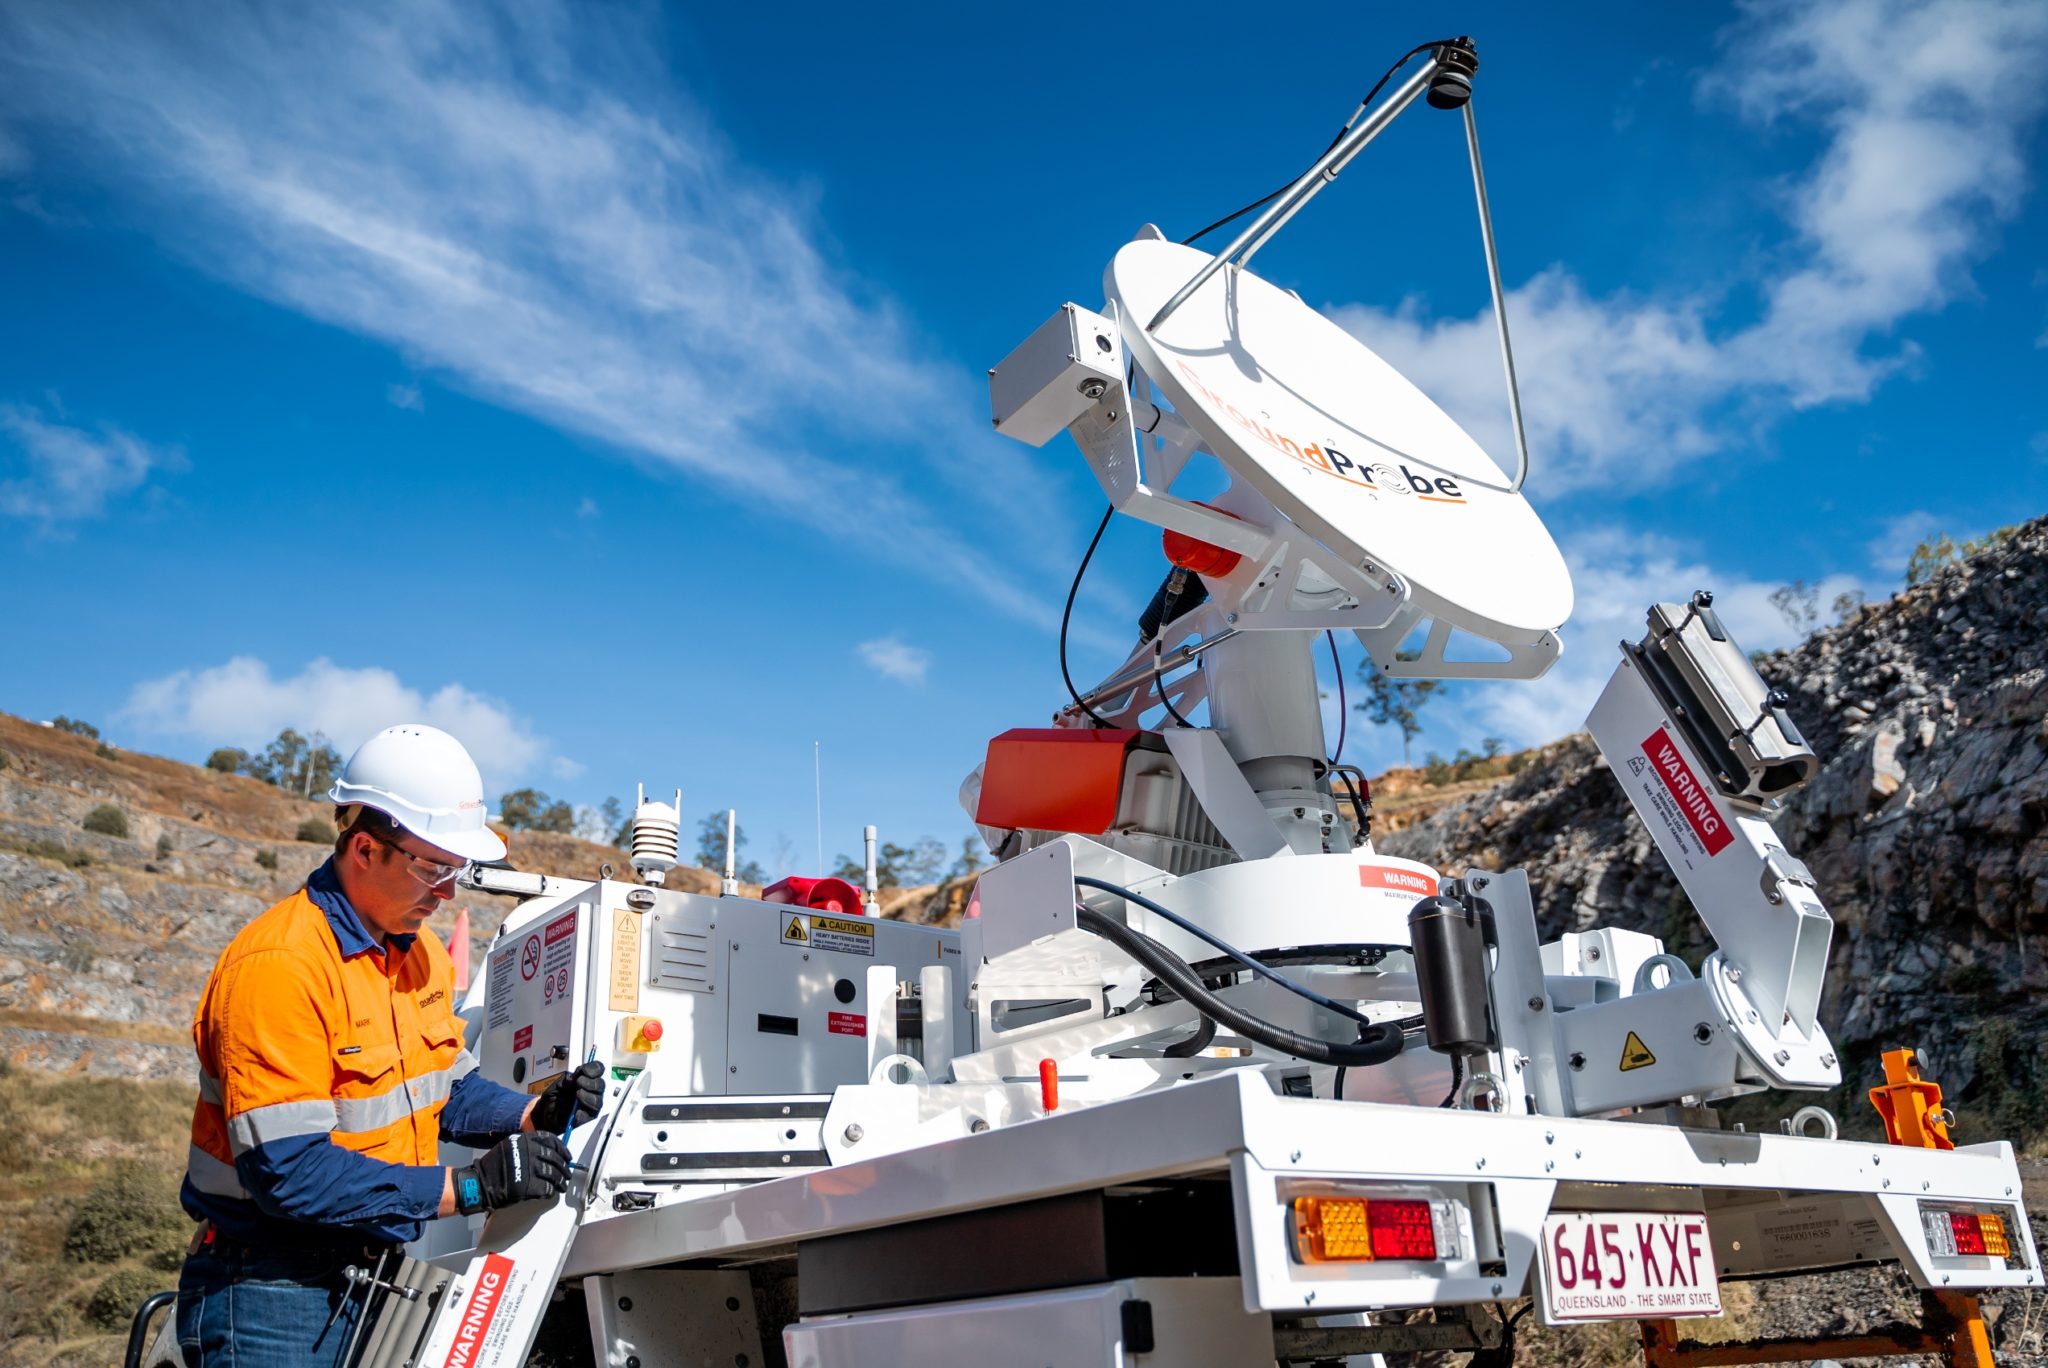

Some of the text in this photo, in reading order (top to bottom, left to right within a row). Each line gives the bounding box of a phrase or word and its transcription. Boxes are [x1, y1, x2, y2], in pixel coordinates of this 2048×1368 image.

[1646, 765, 1663, 787] SECURE
[1660, 786, 1669, 797] ALL
[1666, 796, 1679, 812] LEGS
[1675, 810, 1693, 833] BEFORE
[1688, 832, 1707, 855] DRIVING
[1658, 744, 1719, 835] WARNING
[1641, 782, 1654, 797] TAKE
[1650, 795, 1662, 811] CARE
[1658, 810, 1673, 828] WHILE
[1669, 826, 1690, 855] HANDLING
[1655, 792, 1675, 819] SWINGING
[1671, 817, 1684, 833] LEGS
[1384, 872, 1427, 890] WARNING
[547, 918, 573, 940] WARNING
[828, 921, 867, 934] CAUTION
[559, 974, 566, 986] 25
[511, 1140, 521, 1183] PHOENIX
[447, 1272, 501, 1368] WARNING
[484, 1335, 493, 1347] ALL
[489, 1318, 500, 1334] LEGS
[496, 1294, 509, 1318] BEFORE
[505, 1268, 519, 1294] DRIVING
[491, 1317, 507, 1348] SWINGING
[503, 1300, 514, 1317] LEGS
[1559, 1295, 1626, 1310] QUEENSLAND
[1638, 1294, 1655, 1306] THE
[1658, 1293, 1686, 1305] SMART
[1689, 1293, 1713, 1305] STATE
[491, 1283, 528, 1367] TAKE CARE WHILE HANDLING
